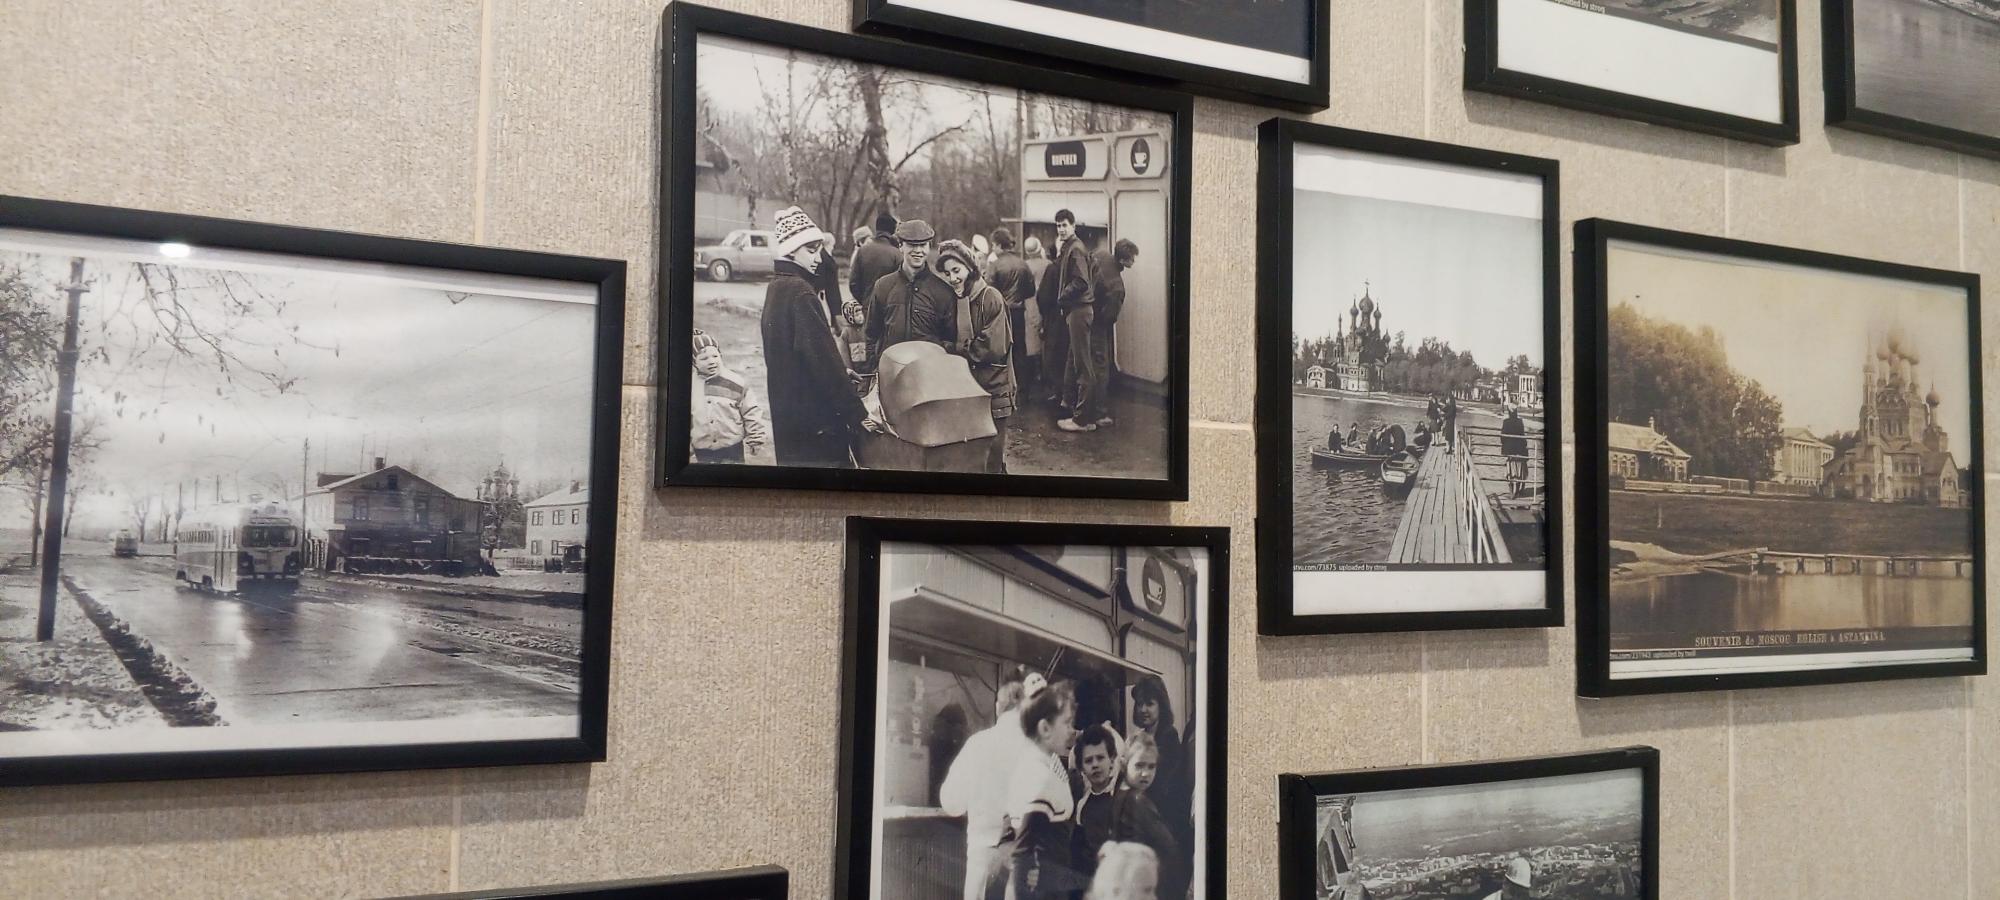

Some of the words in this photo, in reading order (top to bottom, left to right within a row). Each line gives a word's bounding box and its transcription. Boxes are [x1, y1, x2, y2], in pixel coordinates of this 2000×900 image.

[1338, 563, 1365, 572] uploaded
[1365, 563, 1374, 572] by
[1695, 635, 1742, 647] SOUVENIR
[1745, 635, 1755, 645] de
